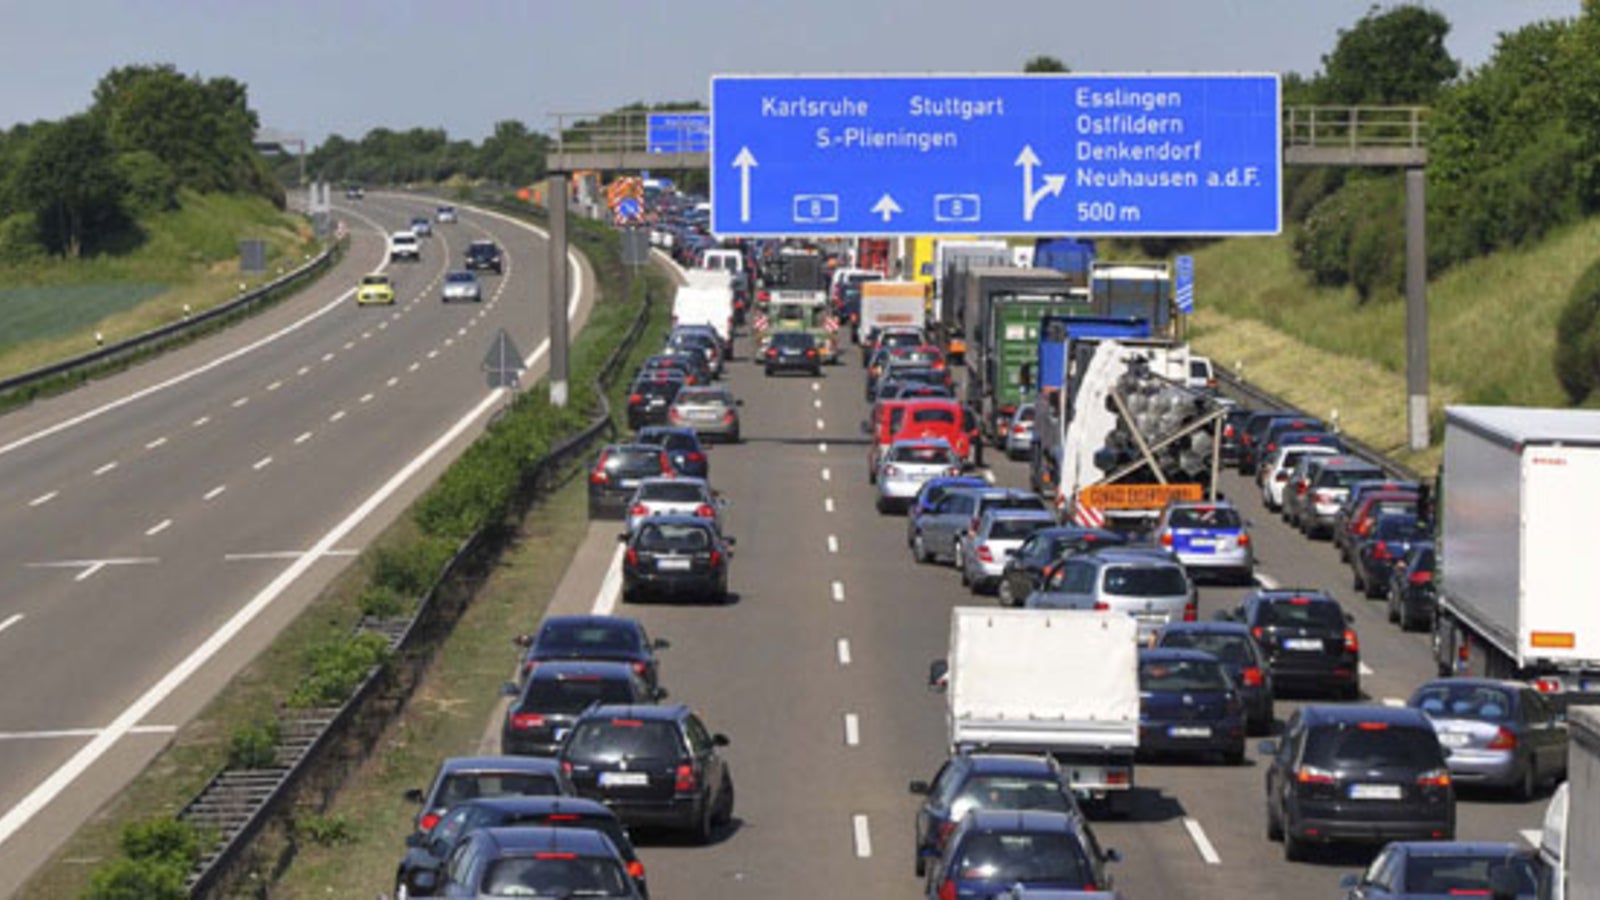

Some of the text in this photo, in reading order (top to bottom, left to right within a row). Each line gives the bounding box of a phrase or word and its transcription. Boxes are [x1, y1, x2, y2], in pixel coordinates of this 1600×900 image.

[762, 98, 868, 116] Karlsruhe
[910, 96, 1004, 119] Stuttgart
[1076, 87, 1181, 110] Esslingen
[1077, 115, 1182, 134] Ostfildern
[817, 128, 957, 151] S.-Plieningen
[1077, 141, 1201, 161] Denkendorf
[1077, 168, 1261, 187] Neuhausen a.d.F.
[811, 201, 822, 216] 8
[952, 201, 963, 216] 8
[1077, 202, 1140, 221] 500 m
